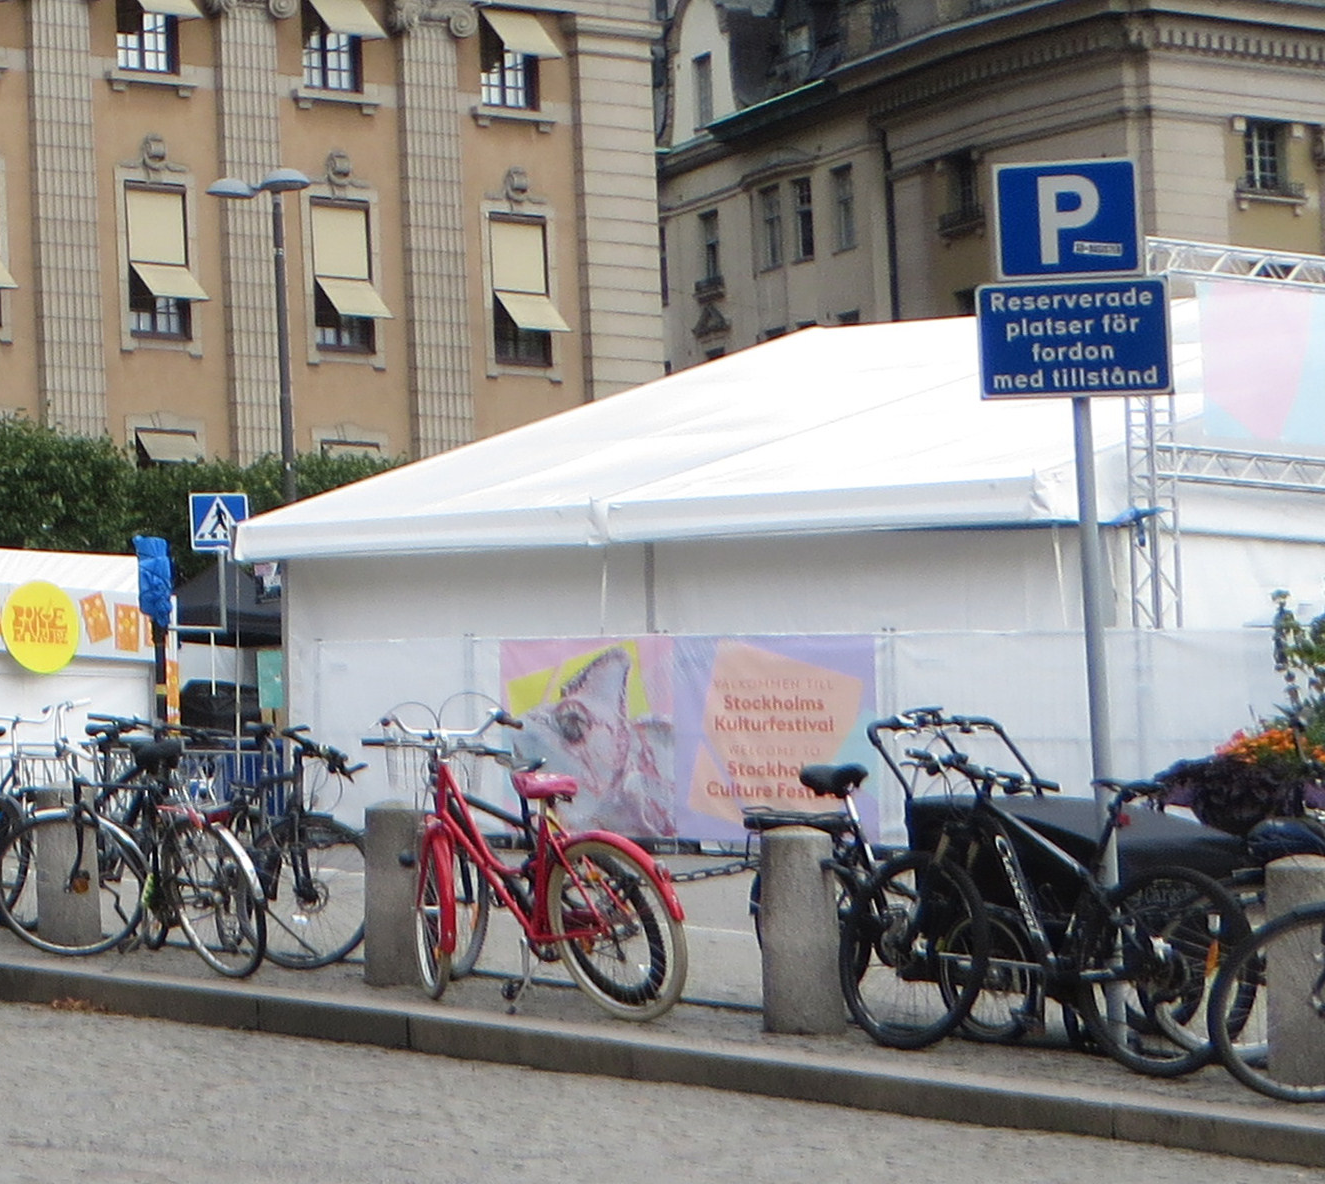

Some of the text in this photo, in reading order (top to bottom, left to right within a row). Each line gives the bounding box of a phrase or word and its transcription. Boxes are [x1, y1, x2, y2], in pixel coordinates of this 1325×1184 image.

[1037, 174, 1099, 265] P
[990, 288, 1153, 313] Reserverade
[1006, 314, 1140, 342] platser för
[1032, 342, 1115, 362] fordon
[993, 366, 1158, 389] med tillstånd
[724, 695, 825, 711] Stockholms
[714, 715, 835, 732] Kulturfestival
[727, 760, 805, 777] Stockho
[706, 780, 773, 797] Culture
